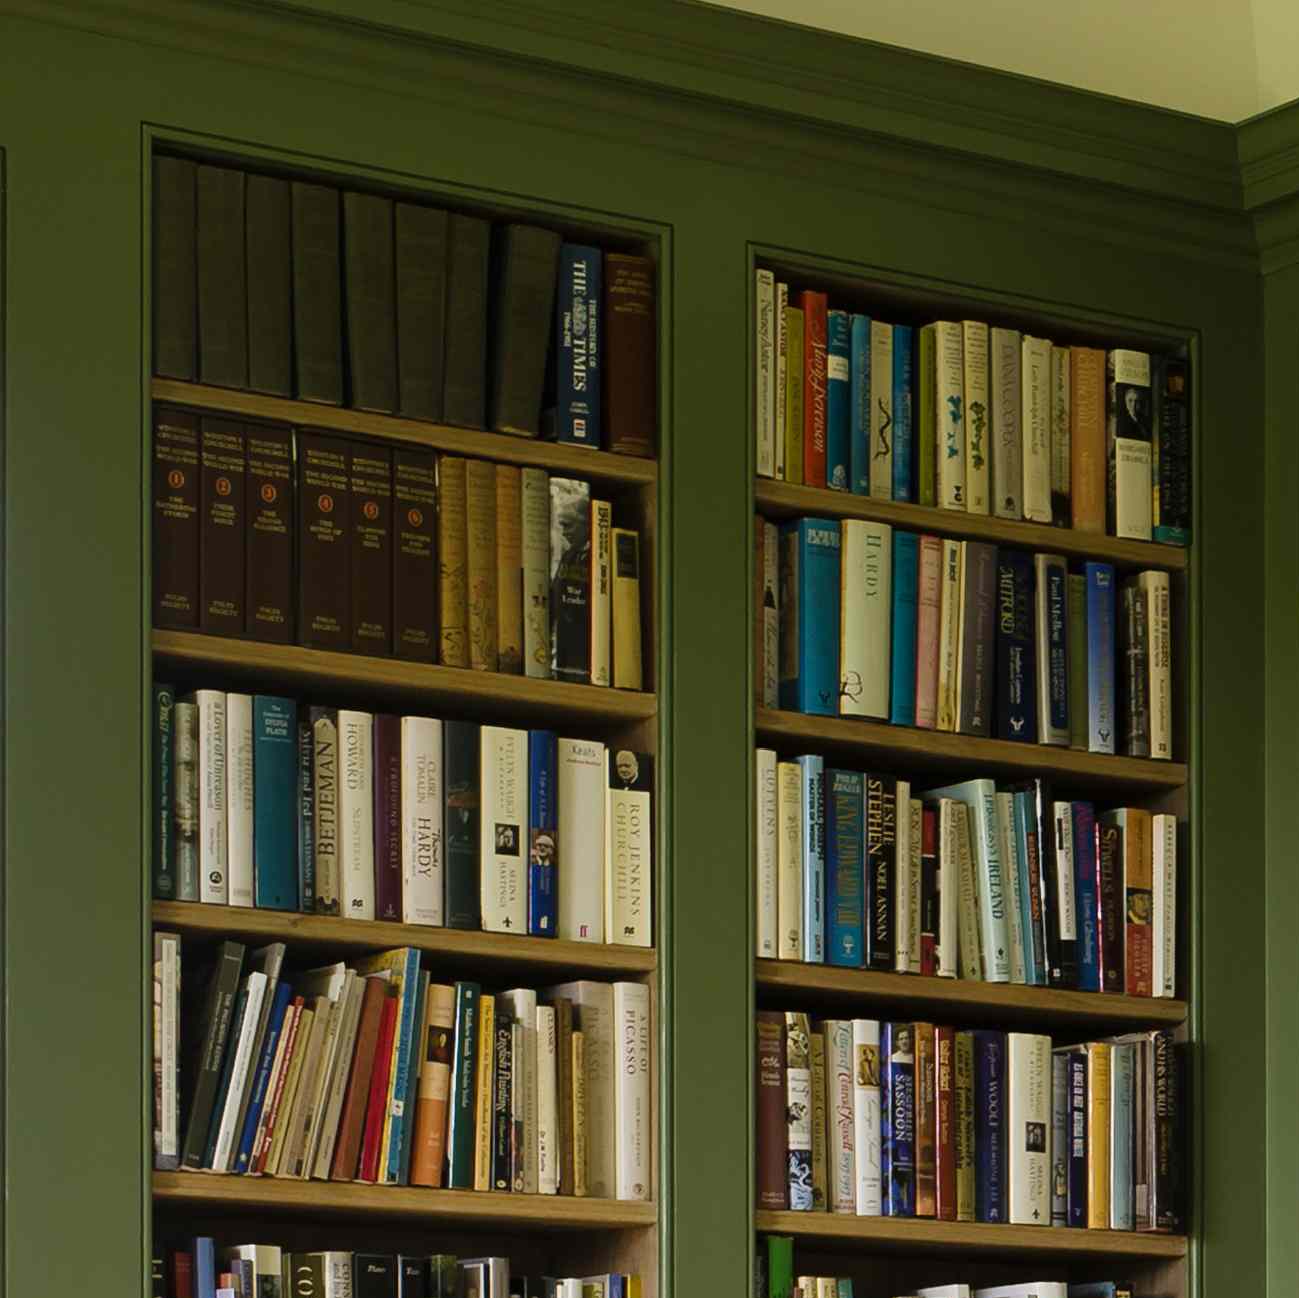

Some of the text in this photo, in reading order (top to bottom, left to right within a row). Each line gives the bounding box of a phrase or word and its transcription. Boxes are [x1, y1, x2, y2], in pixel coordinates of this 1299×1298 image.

[573, 260, 587, 392] THE TIMES
[865, 534, 882, 600] HARDY
[999, 566, 1018, 634] MITFORD
[1051, 576, 1065, 641] Paul Mellon
[213, 711, 225, 743] Lover
[213, 744, 225, 756] of
[346, 723, 358, 791] HOWARD
[213, 758, 225, 811] Unreason
[302, 731, 313, 816] Sylvia and Ted
[316, 740, 335, 856] BETJEMAN
[416, 754, 426, 804] TOMALIN
[428, 761, 437, 798] CLAIRE
[766, 769, 777, 837] LUTYENS
[353, 808, 361, 871] SLIPSTREAM
[417, 817, 431, 879] HARDY
[431, 828, 441, 868] Thomas
[867, 778, 883, 855] STEPHEN
[883, 793, 896, 845] LESLIE
[616, 802, 627, 902] CHURCHILL
[631, 804, 641, 916] ROY JENKINS
[1102, 828, 1118, 895] SITWELLS
[499, 862, 508, 909] HASTINGS
[876, 861, 888, 942] NOEL ANNAN
[987, 858, 1005, 919] IRELAND
[496, 1030, 511, 1112] English Painting
[625, 1009, 637, 1075] PICASSO
[640, 1027, 648, 1073] LIFE OF
[837, 1072, 854, 1151] Conrad Russell
[895, 1073, 905, 1142] SASSOON
[988, 1080, 1000, 1127] WOOLF
[1157, 1080, 1167, 1117] WORLD
